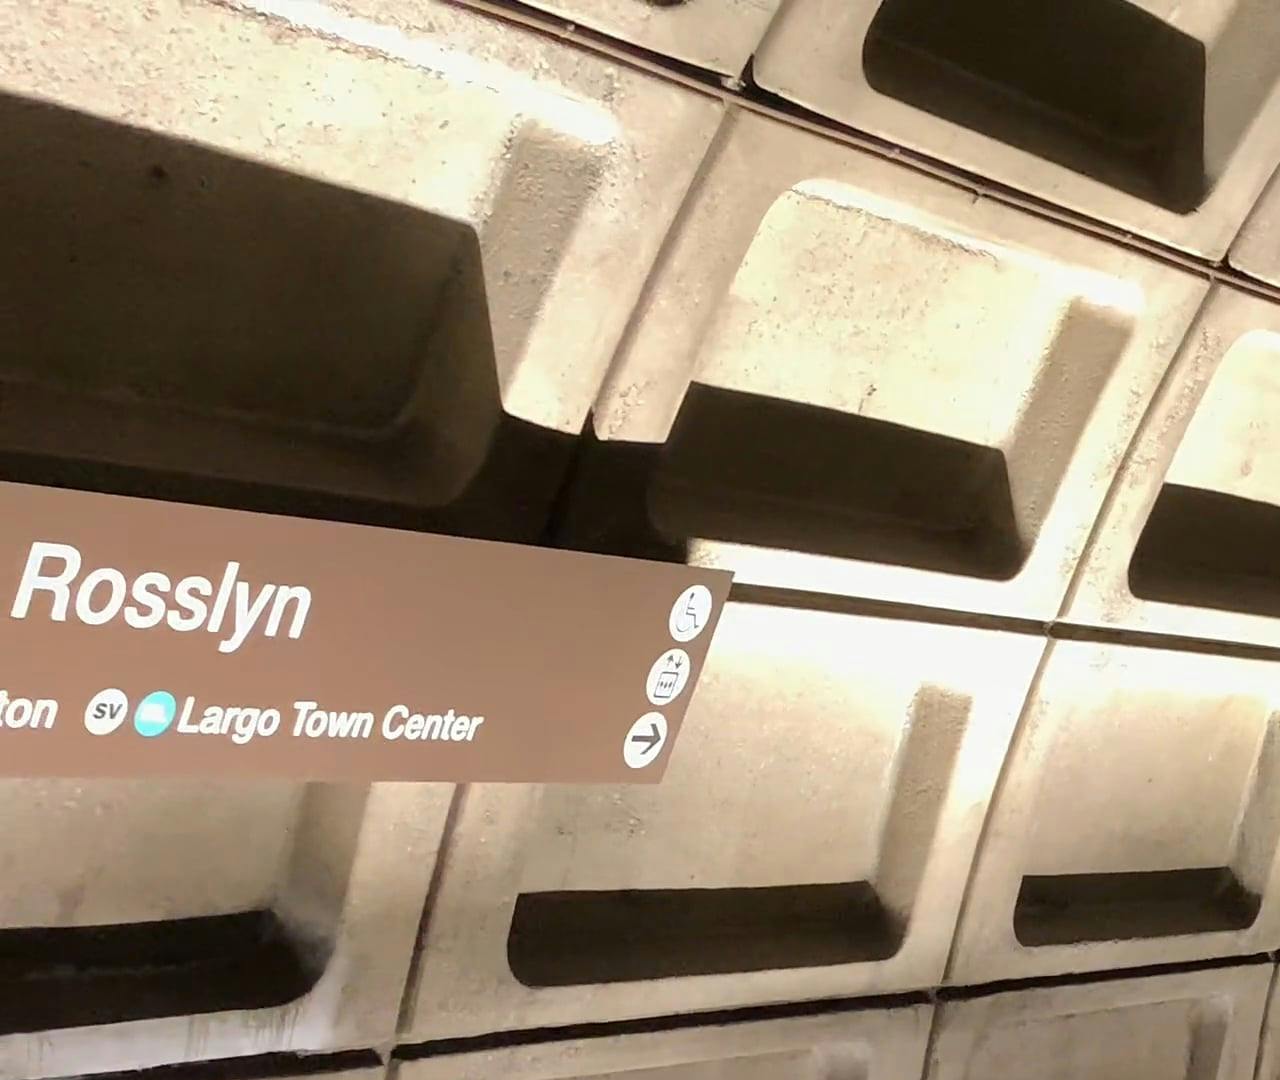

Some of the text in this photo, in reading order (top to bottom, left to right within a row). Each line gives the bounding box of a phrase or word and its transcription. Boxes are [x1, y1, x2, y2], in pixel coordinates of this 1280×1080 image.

[10, 541, 312, 654] Rosslyn
[92, 702, 123, 720] SV
[177, 696, 280, 745] Largo
[292, 700, 374, 738] Town
[381, 704, 484, 741] Center
